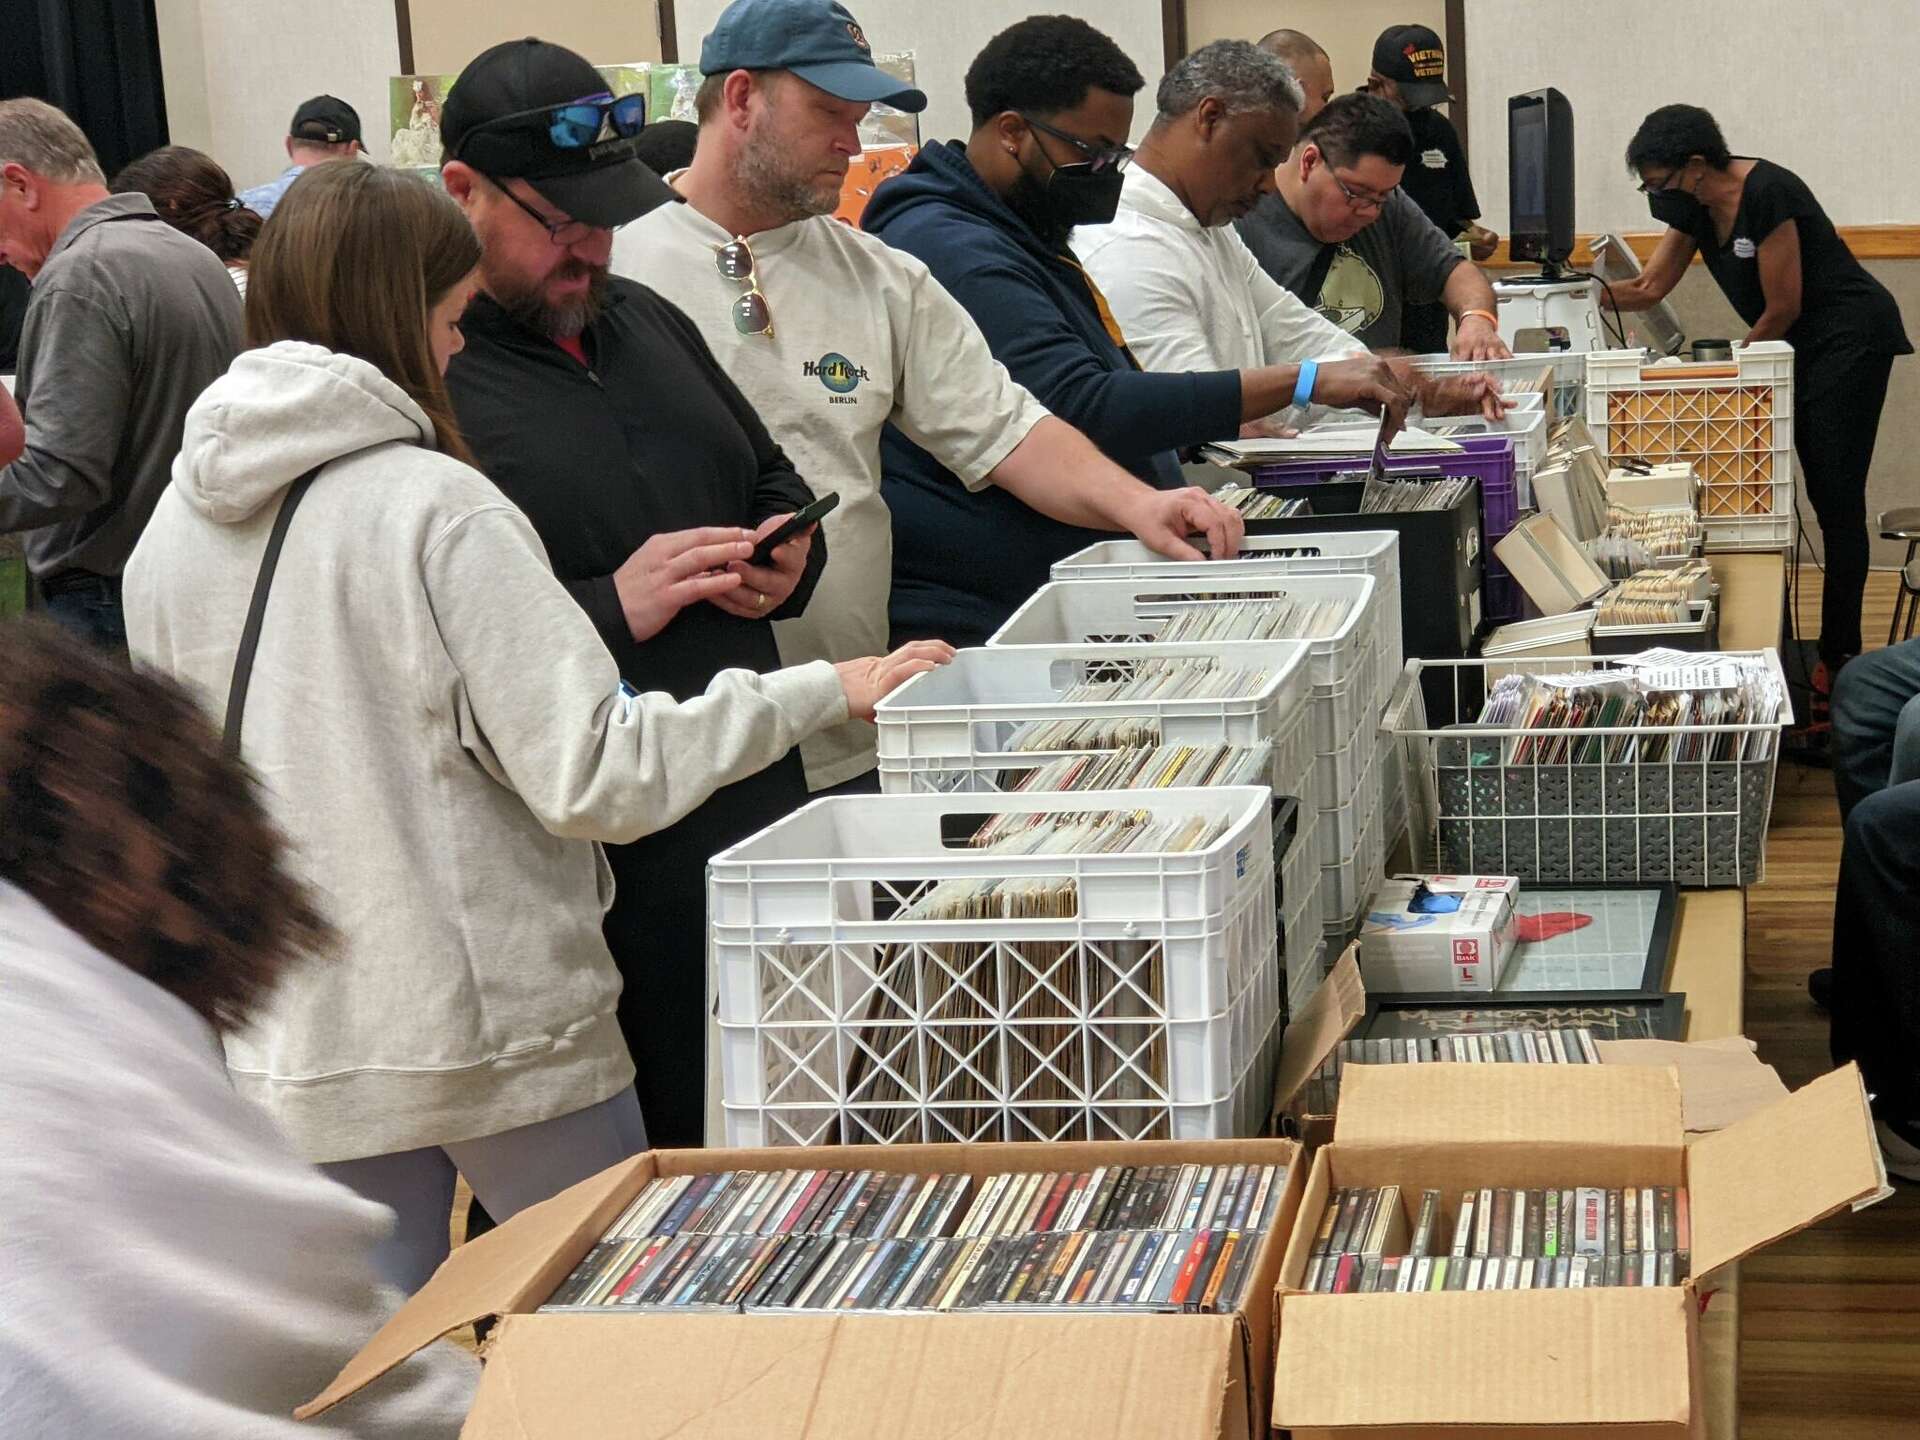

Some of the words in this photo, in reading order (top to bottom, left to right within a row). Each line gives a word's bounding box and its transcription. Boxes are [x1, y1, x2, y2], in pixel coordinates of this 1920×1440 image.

[803, 361, 836, 376] Hard
[839, 362, 870, 381] Rock
[829, 396, 857, 404] BERLIN
